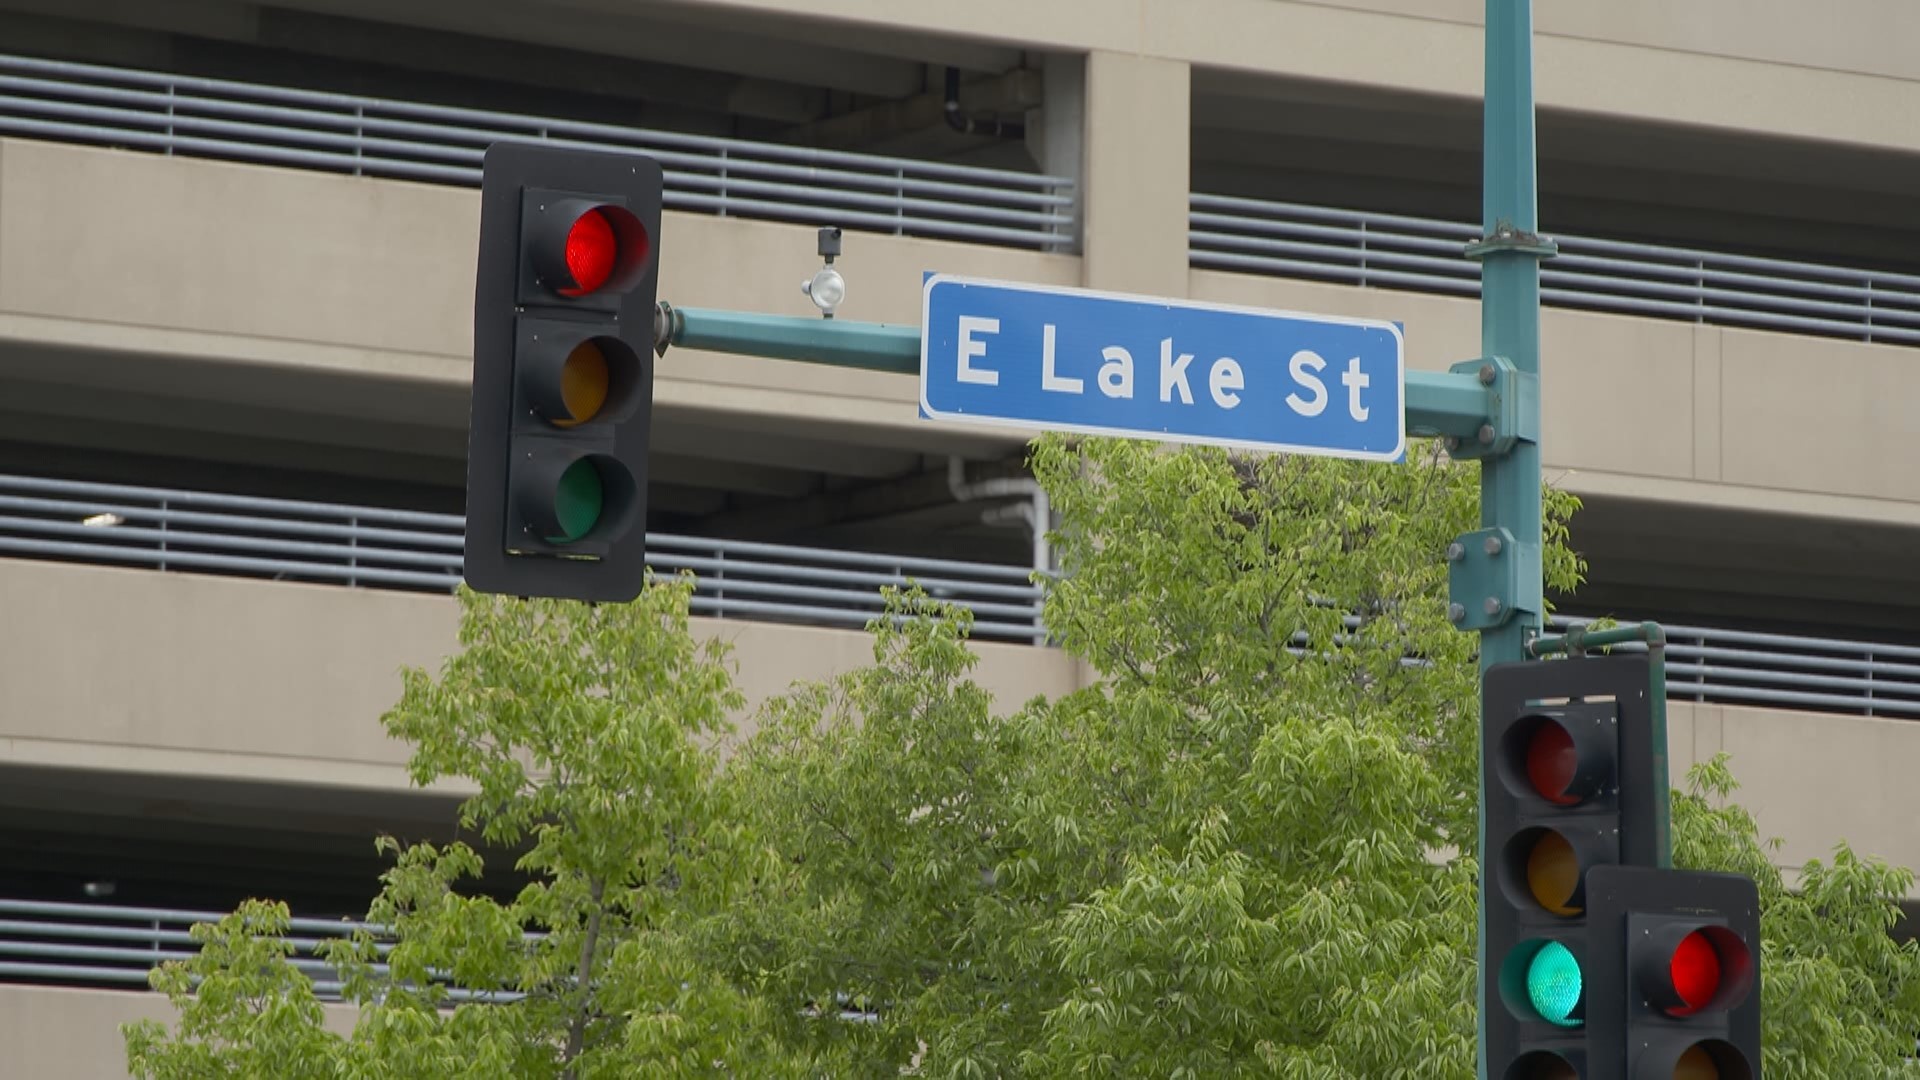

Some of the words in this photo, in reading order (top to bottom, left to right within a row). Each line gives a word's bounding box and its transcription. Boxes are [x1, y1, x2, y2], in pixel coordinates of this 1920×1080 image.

[957, 315, 1000, 386] E
[1041, 323, 1245, 409] Lake
[1285, 350, 1370, 422] St
